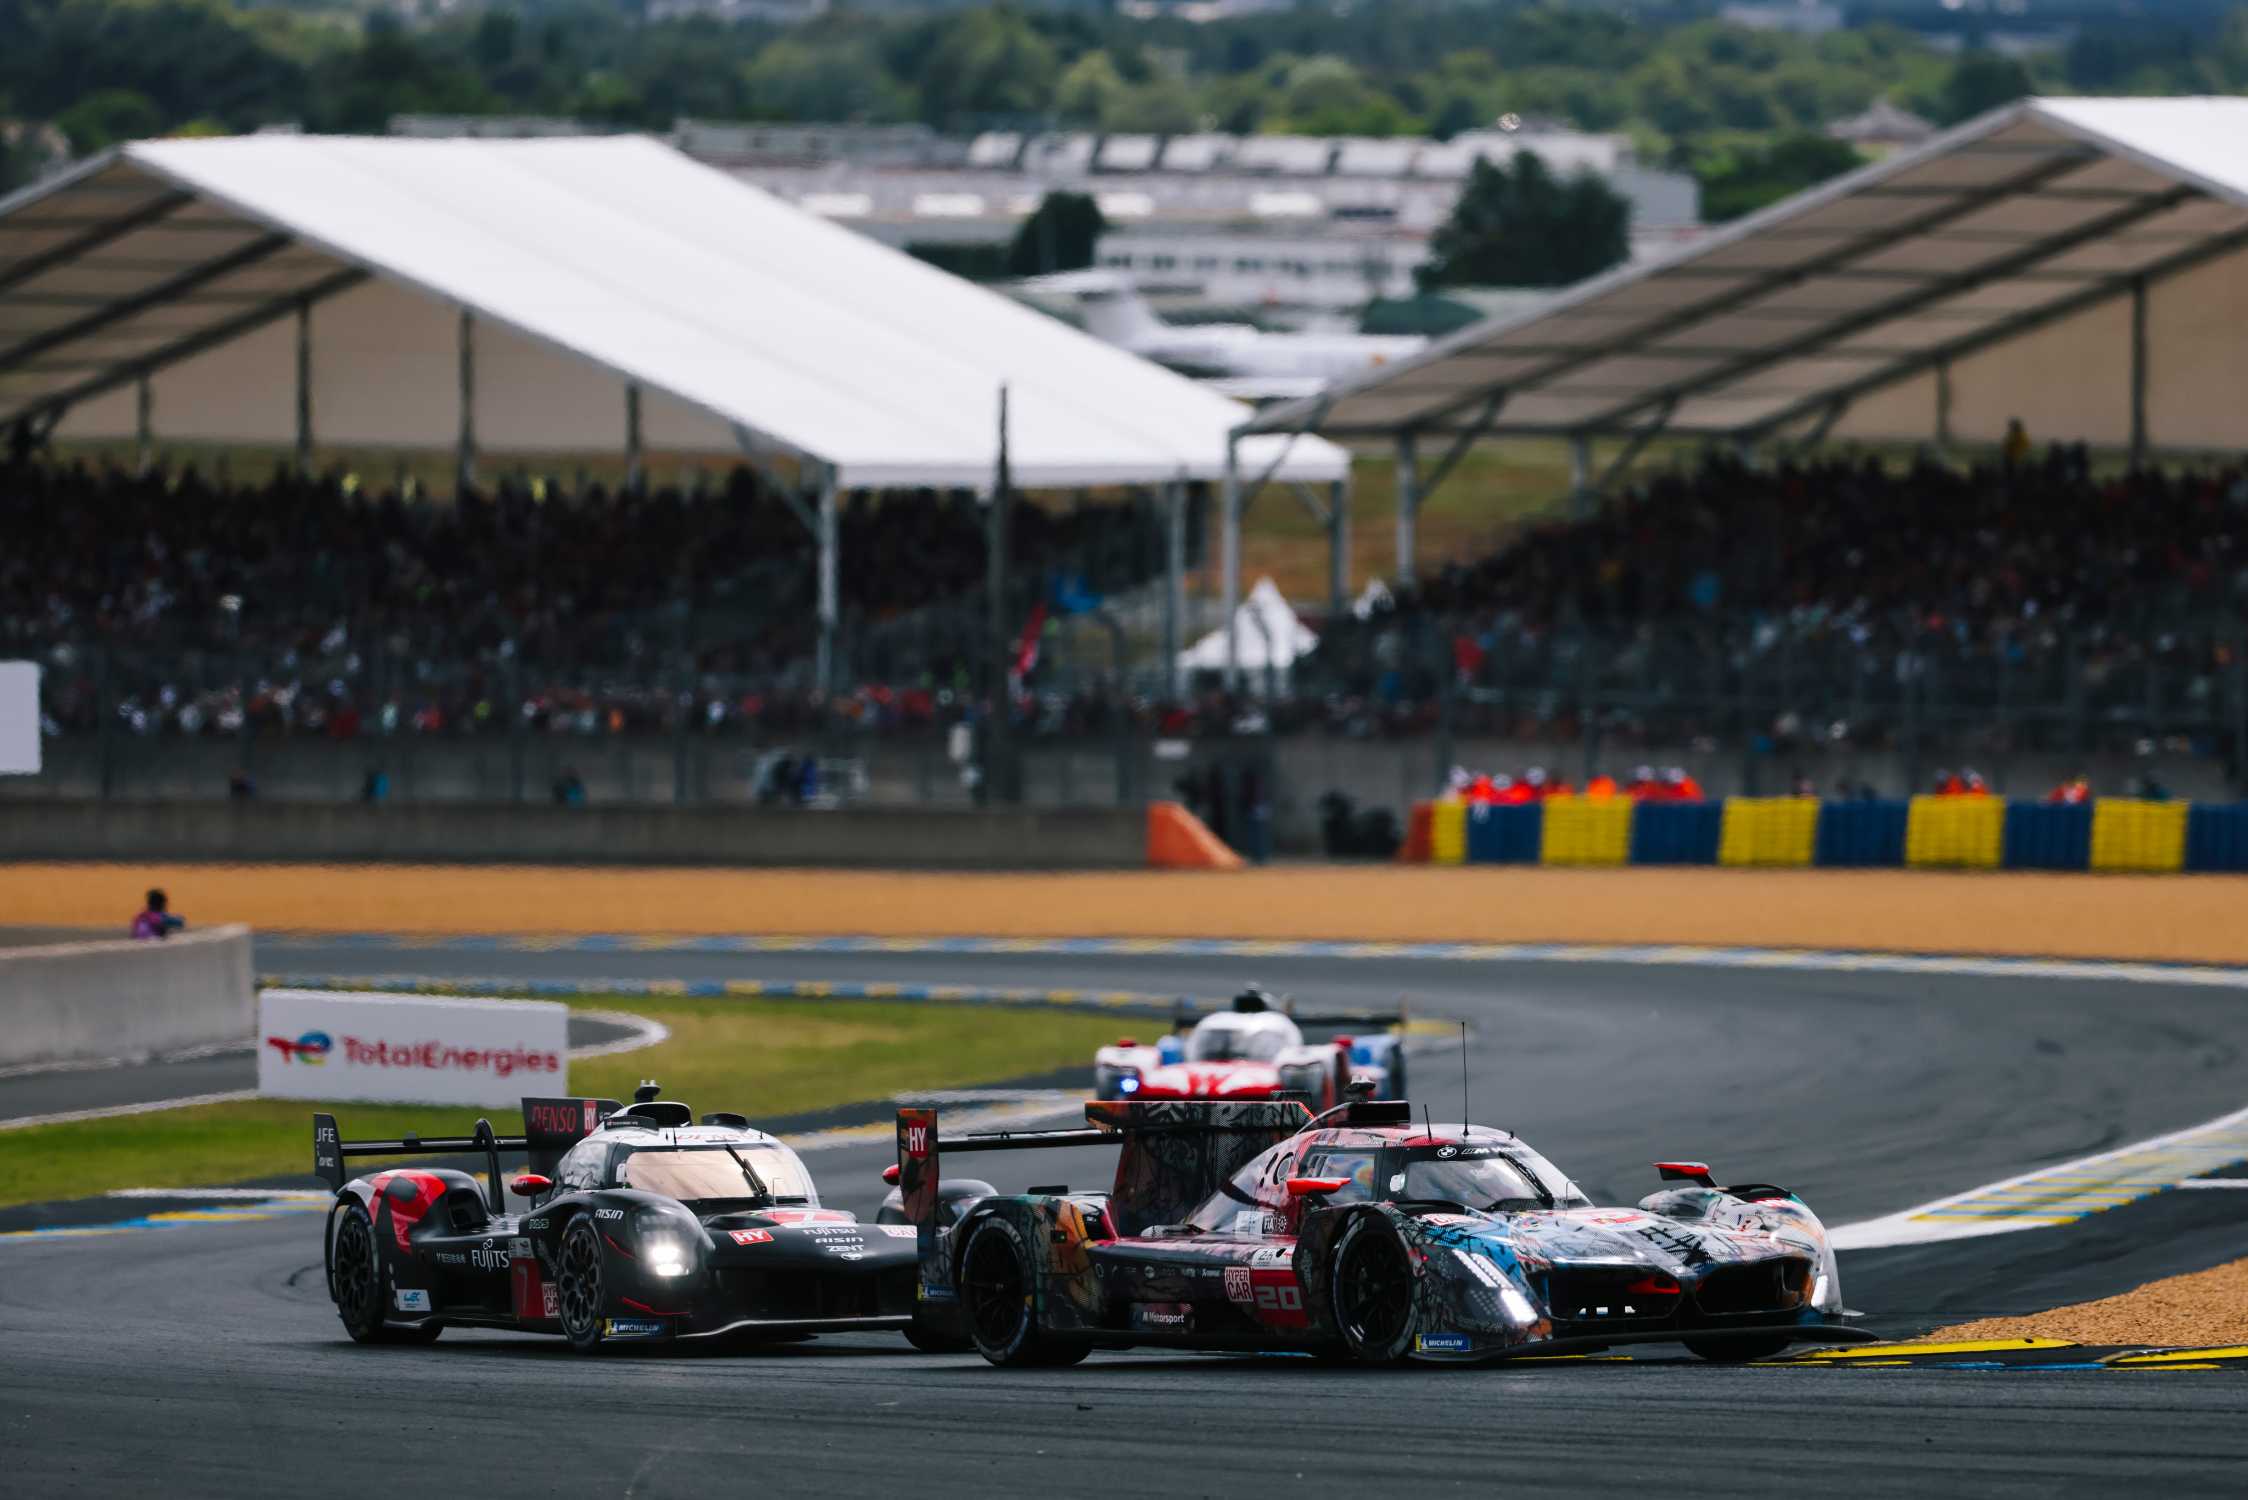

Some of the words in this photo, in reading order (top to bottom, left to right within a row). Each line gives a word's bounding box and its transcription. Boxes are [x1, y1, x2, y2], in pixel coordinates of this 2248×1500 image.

[342, 1035, 559, 1078] TotalEnergies
[530, 1104, 577, 1133] DENSO
[584, 1107, 597, 1131] HY
[316, 1128, 335, 1143] JFE
[909, 1127, 926, 1151] HY
[738, 1230, 766, 1242] HY
[803, 1226, 856, 1236] FUJITSU
[471, 1250, 511, 1272] FUJITS
[1226, 1269, 1249, 1281] HYPER
[1228, 1281, 1252, 1301] CAR
[1254, 1286, 1303, 1310] 20
[544, 1297, 560, 1314] CA
